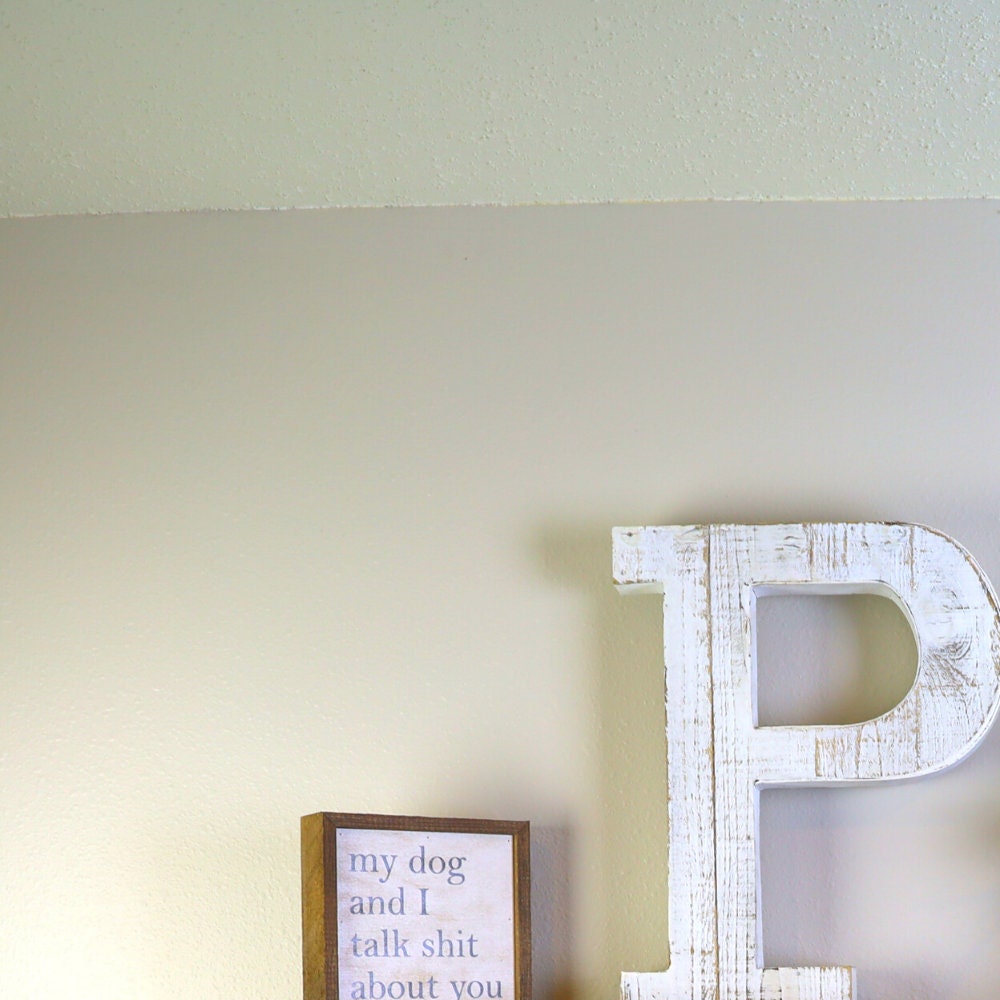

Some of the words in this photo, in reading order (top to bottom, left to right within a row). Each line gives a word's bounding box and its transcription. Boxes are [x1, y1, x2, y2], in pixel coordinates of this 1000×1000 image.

[349, 853, 398, 883] my
[408, 845, 467, 885] dog
[349, 886, 405, 916] and
[419, 888, 430, 916] I
[350, 928, 410, 958] talk
[421, 929, 479, 958] shit
[350, 970, 439, 1000] about
